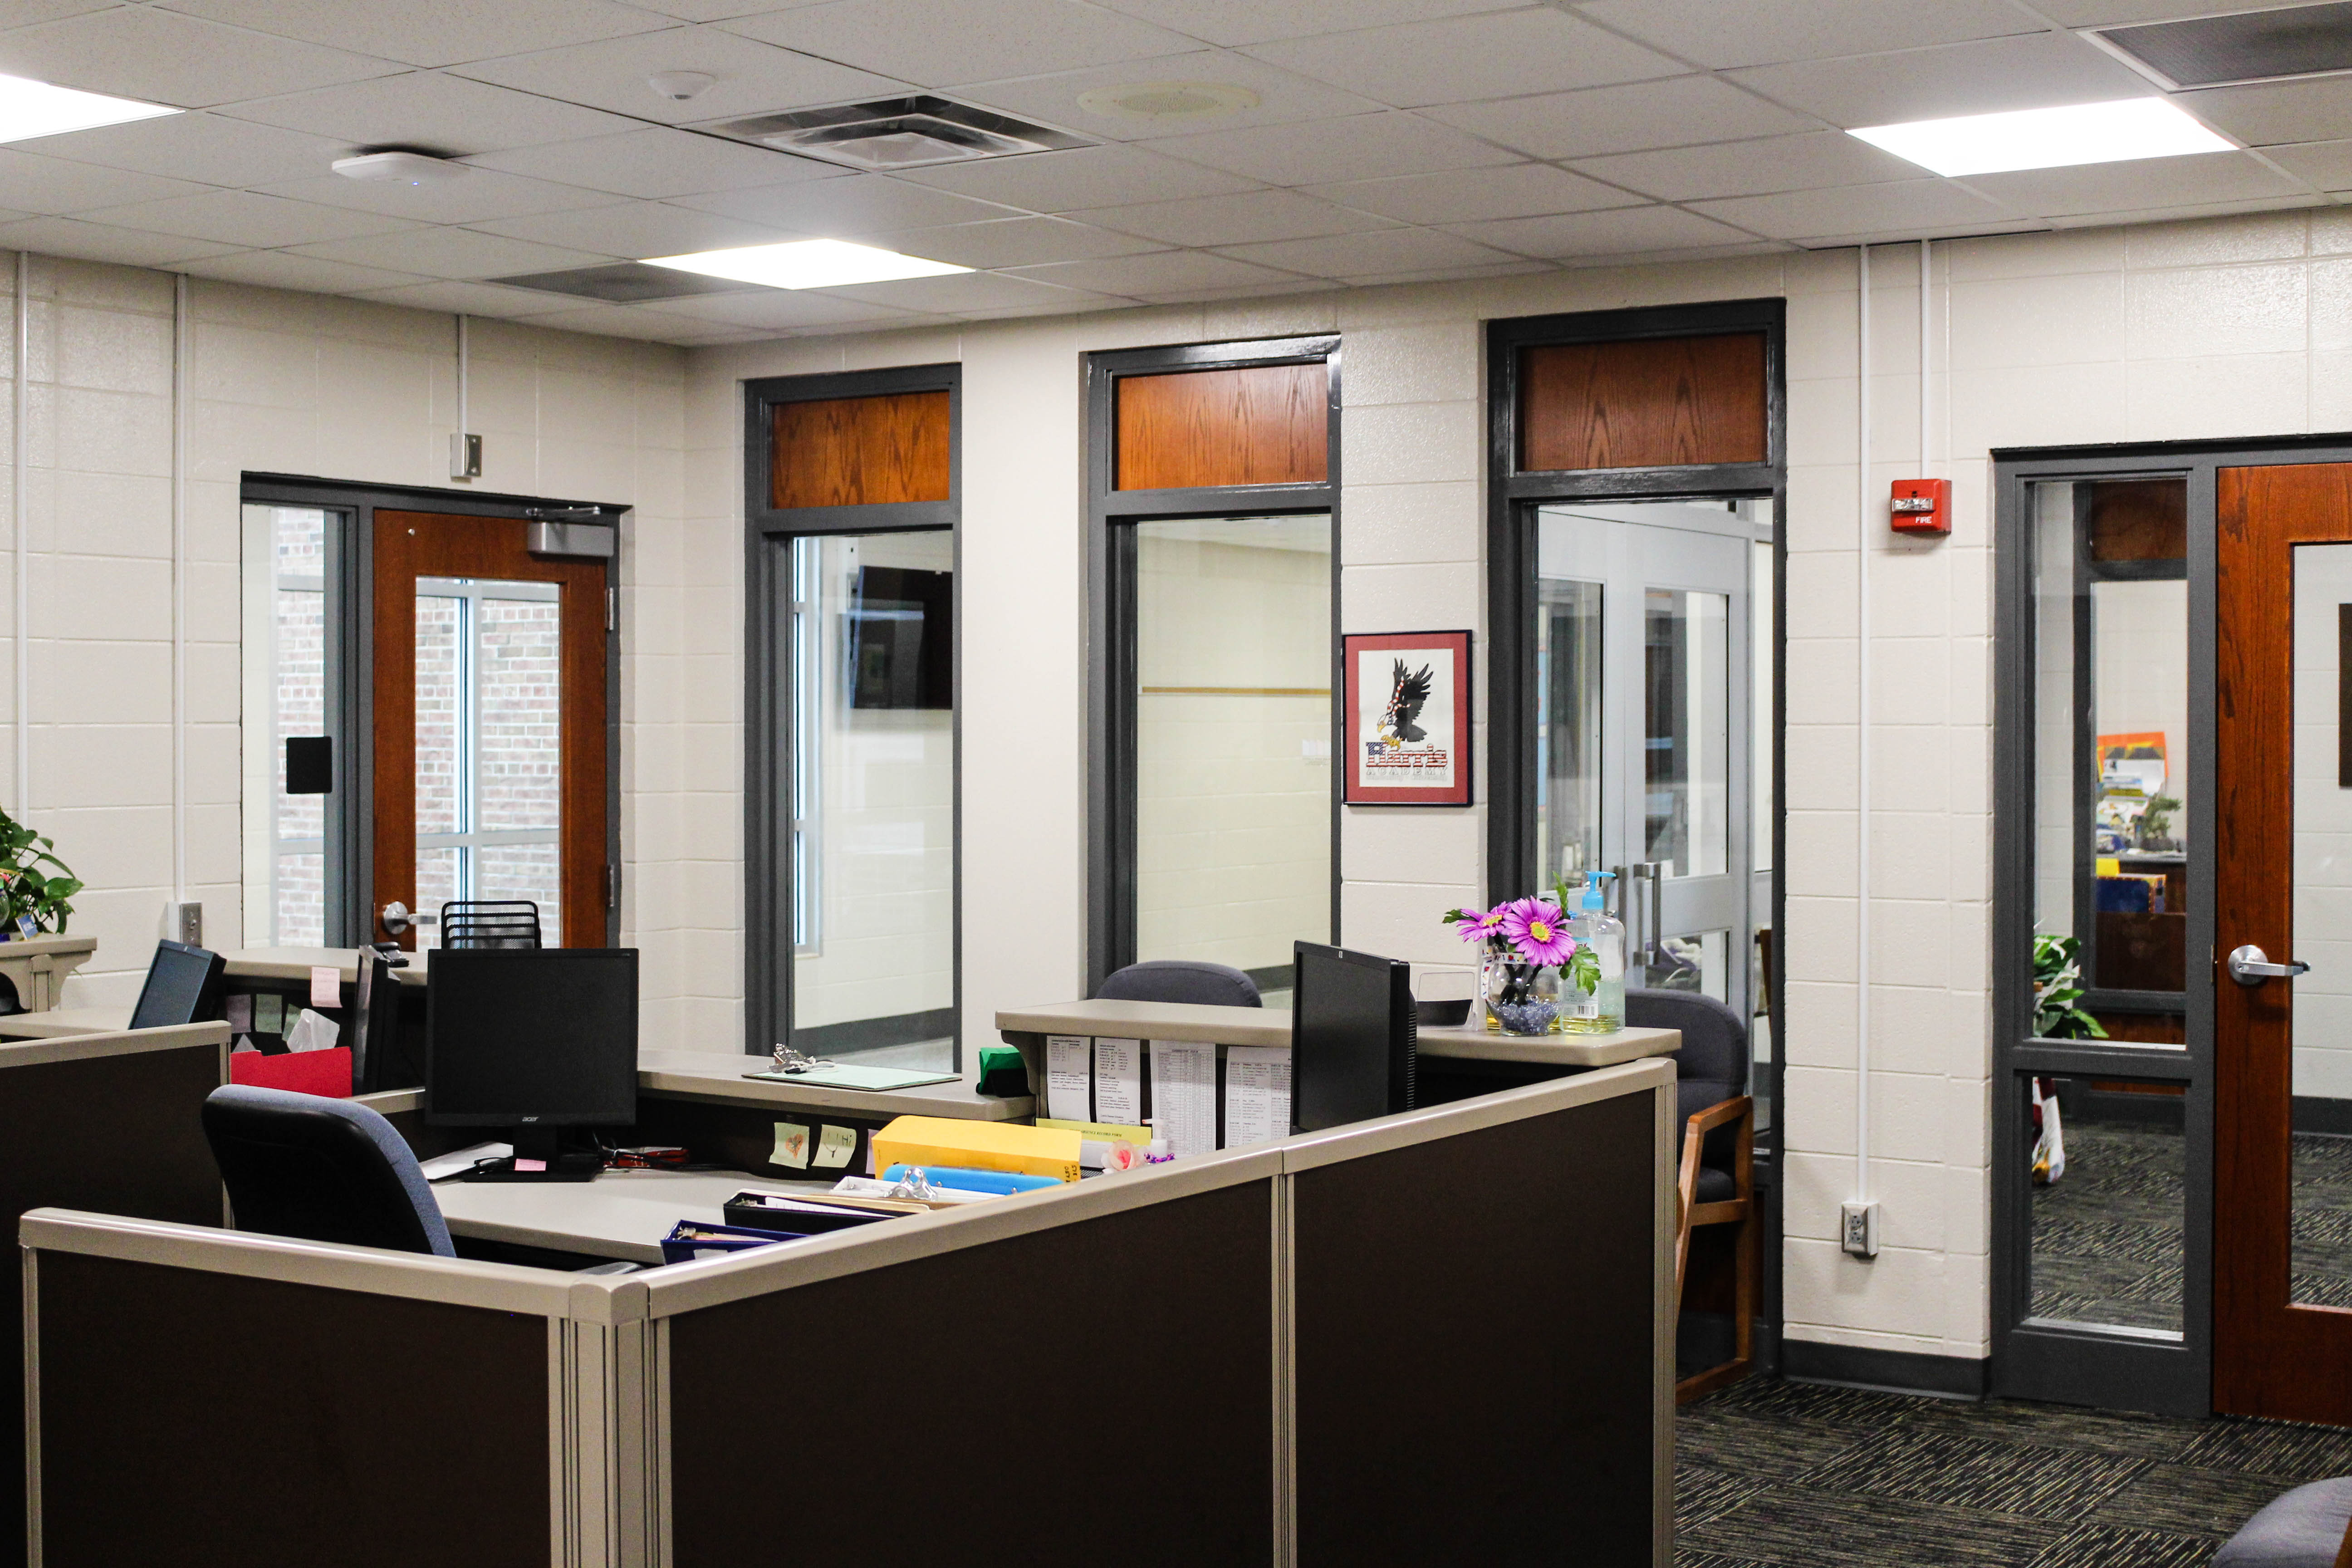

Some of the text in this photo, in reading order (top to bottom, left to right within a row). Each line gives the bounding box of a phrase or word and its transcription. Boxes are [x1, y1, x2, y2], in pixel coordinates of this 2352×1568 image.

[1366, 742, 1447, 767] Harris
[1366, 767, 1448, 775] ACADEMY
[842, 1135, 852, 1147] Hi
